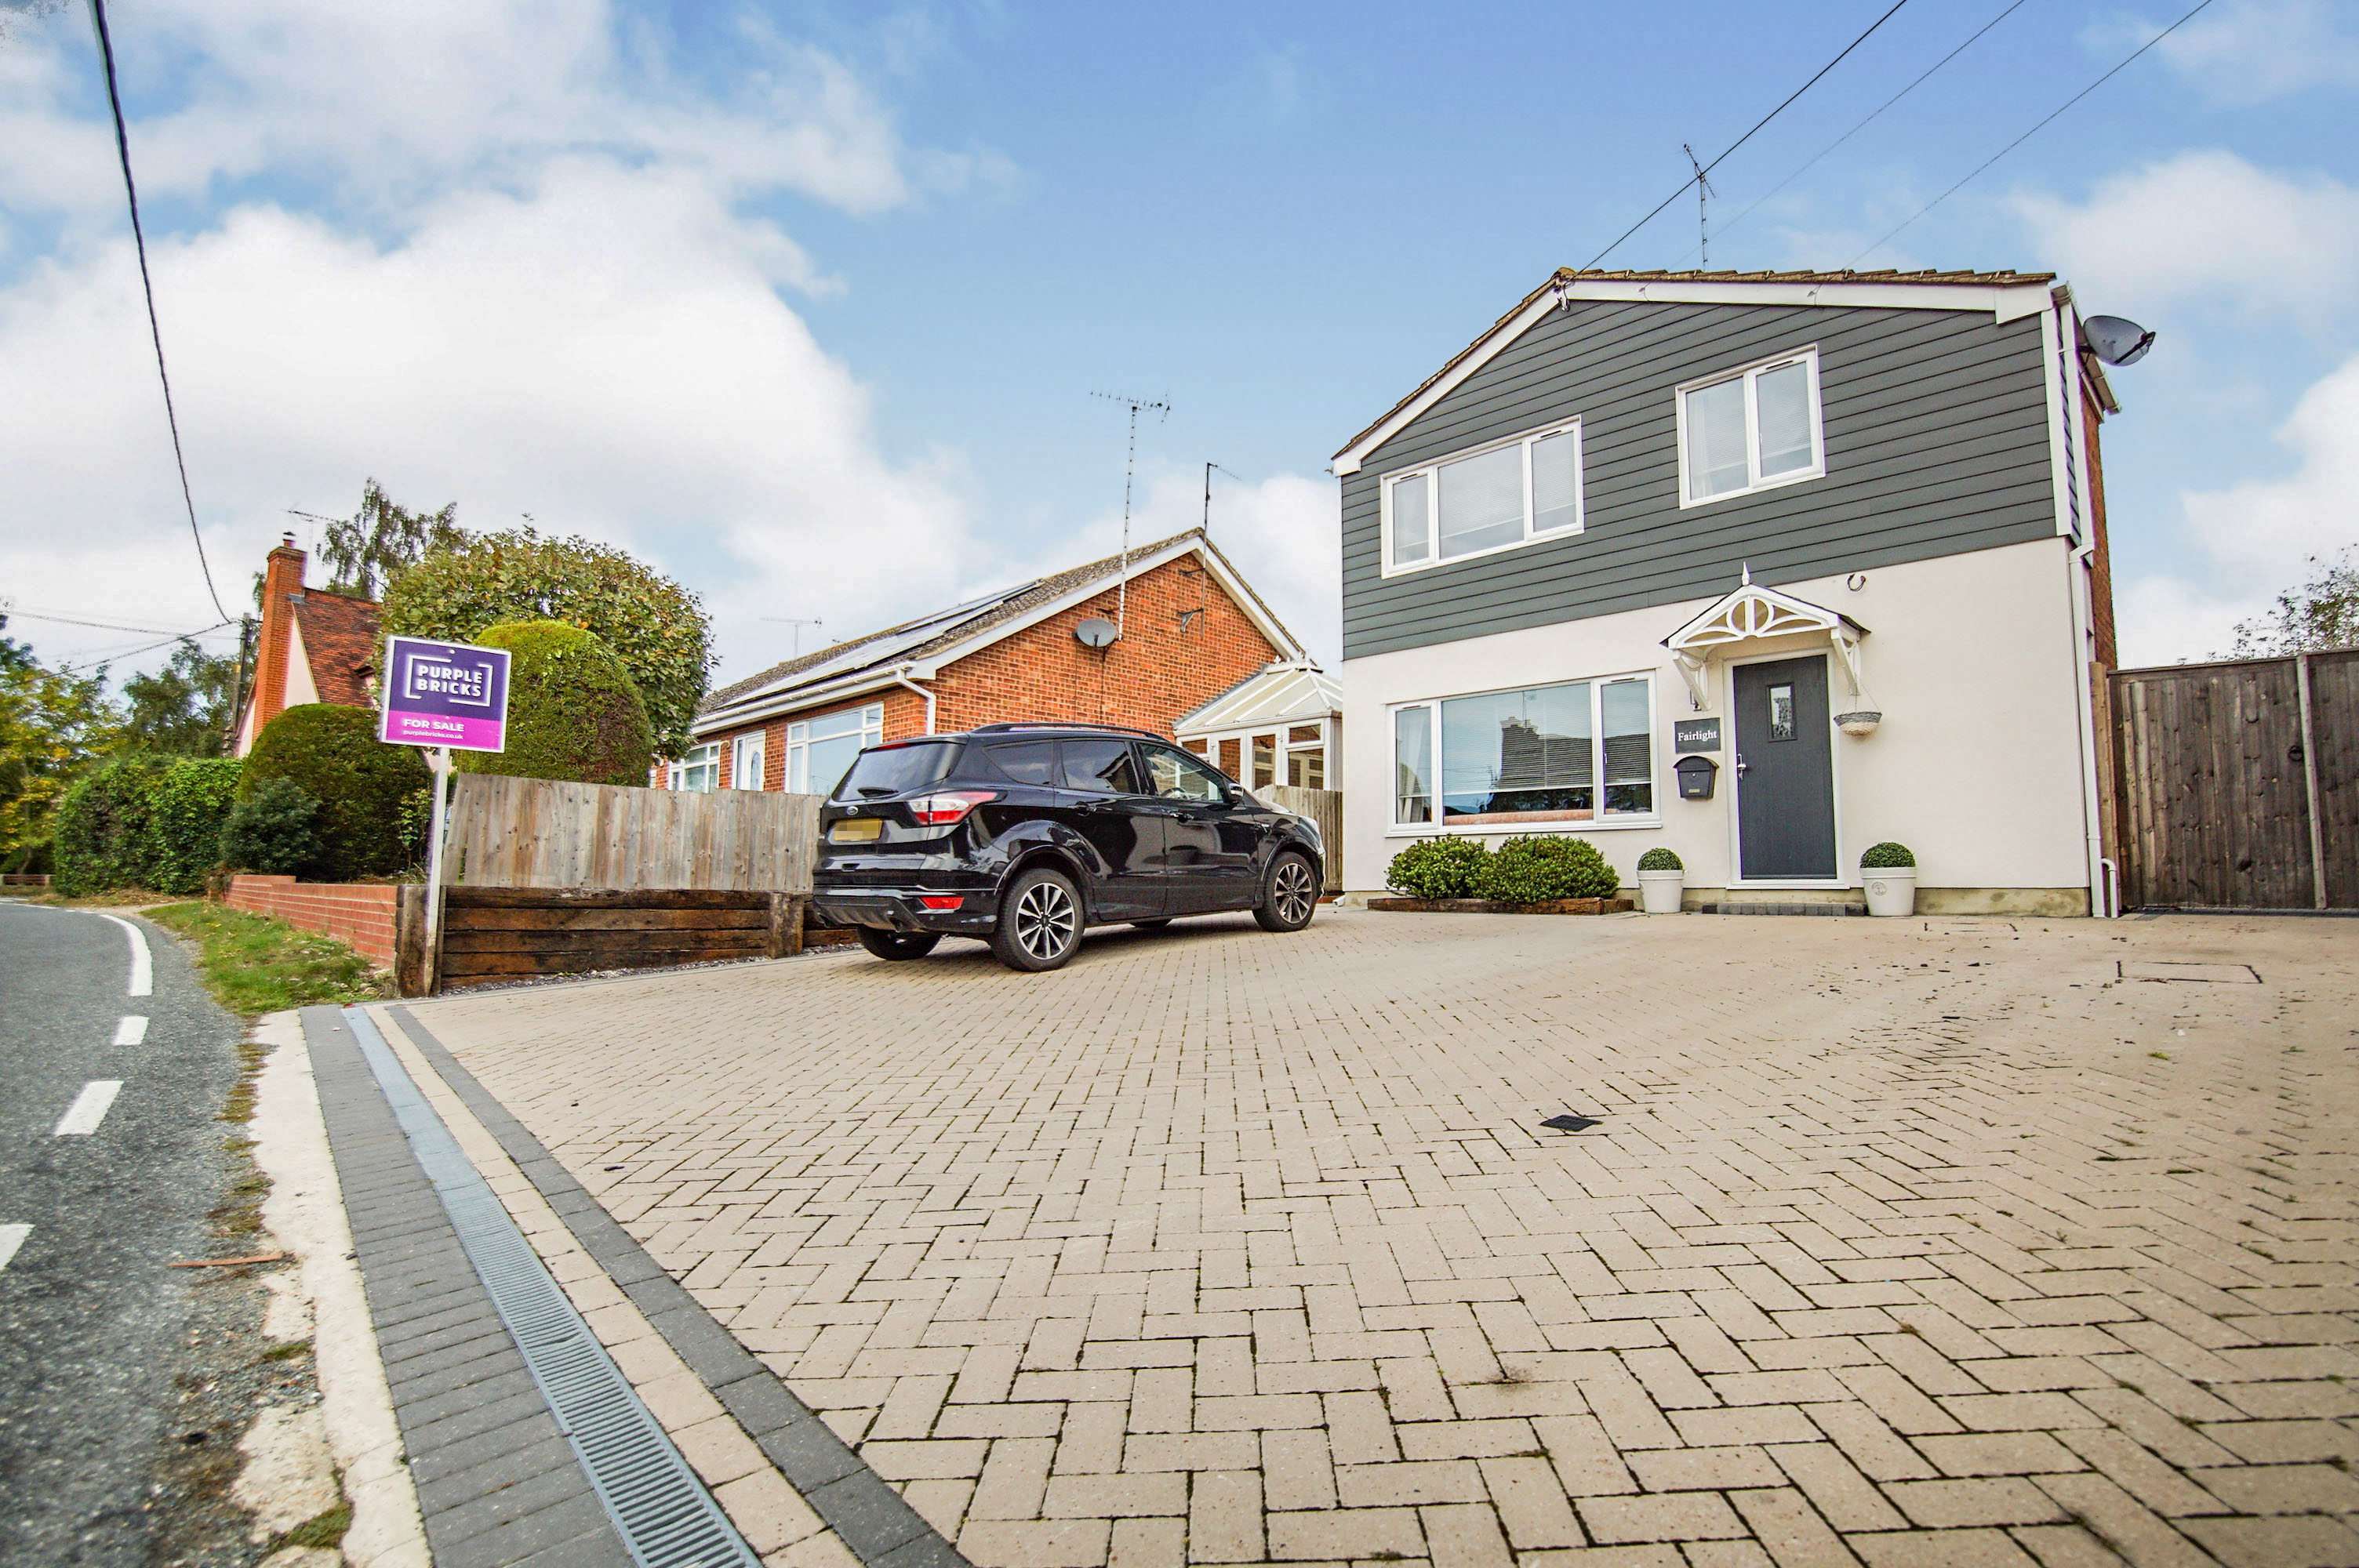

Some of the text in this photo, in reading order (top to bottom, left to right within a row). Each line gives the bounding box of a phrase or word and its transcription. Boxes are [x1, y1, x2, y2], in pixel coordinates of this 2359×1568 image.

[418, 665, 482, 684] PURPLE
[417, 678, 482, 697] BRICKS
[403, 718, 464, 732] FOR SALE
[403, 730, 463, 739] purplebricks.co.uk
[1677, 729, 1717, 742] Fairlight
